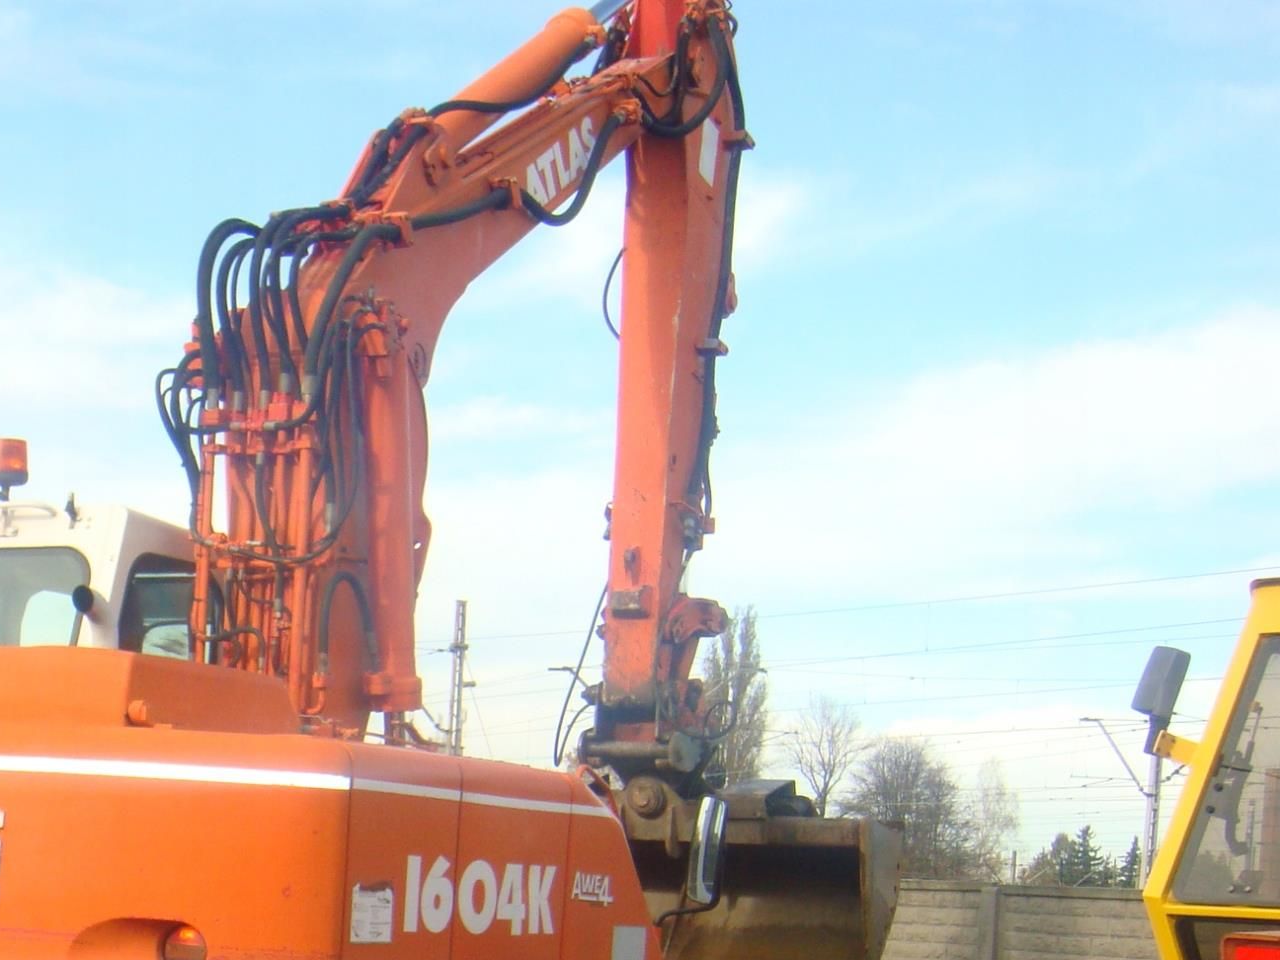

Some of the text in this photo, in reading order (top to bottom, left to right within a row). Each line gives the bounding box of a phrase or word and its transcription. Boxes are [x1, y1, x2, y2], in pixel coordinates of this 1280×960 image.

[527, 117, 596, 204] ATLAS
[403, 854, 557, 936] 1604K
[571, 871, 614, 907] AWE4
